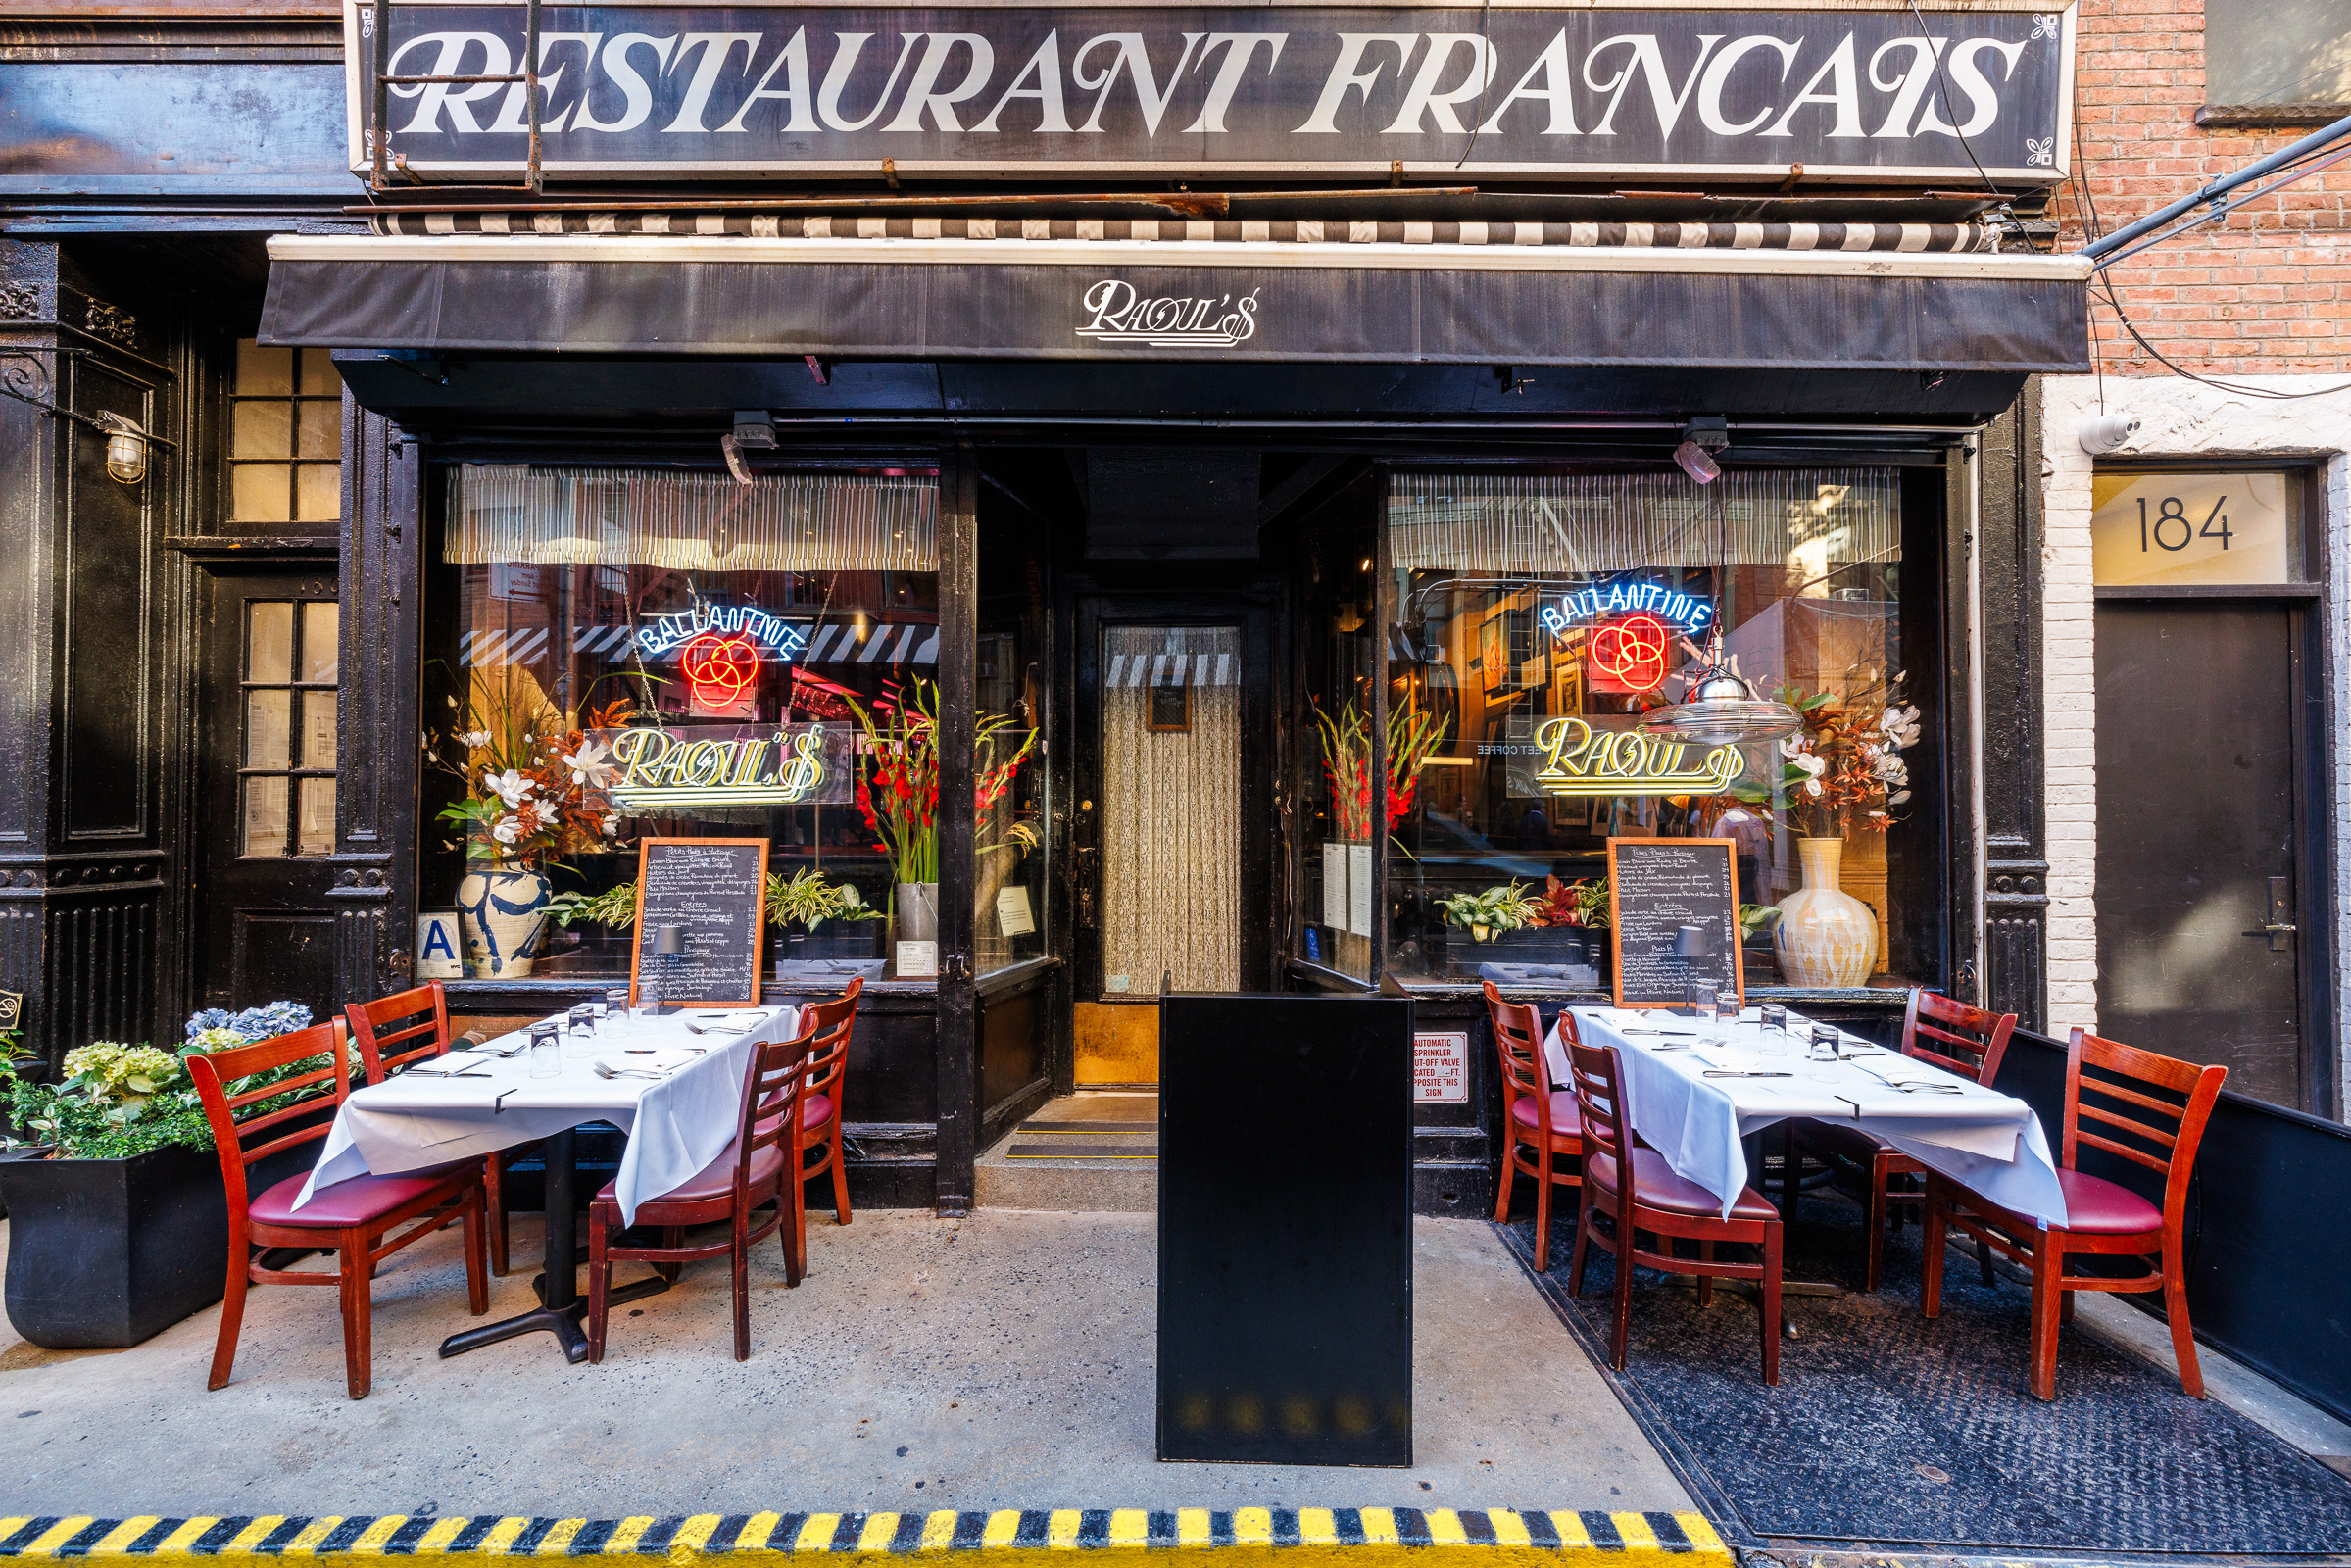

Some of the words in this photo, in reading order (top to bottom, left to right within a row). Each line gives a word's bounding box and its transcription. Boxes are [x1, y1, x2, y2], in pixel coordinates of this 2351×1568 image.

[387, 24, 1289, 139] RESTAURANT
[1291, 26, 2028, 143] FRANCAIS
[1075, 280, 1261, 347] RAOUL'S
[2136, 495, 2233, 552] 184
[1542, 584, 1711, 634] BALLANTINE
[422, 920, 456, 959] A
